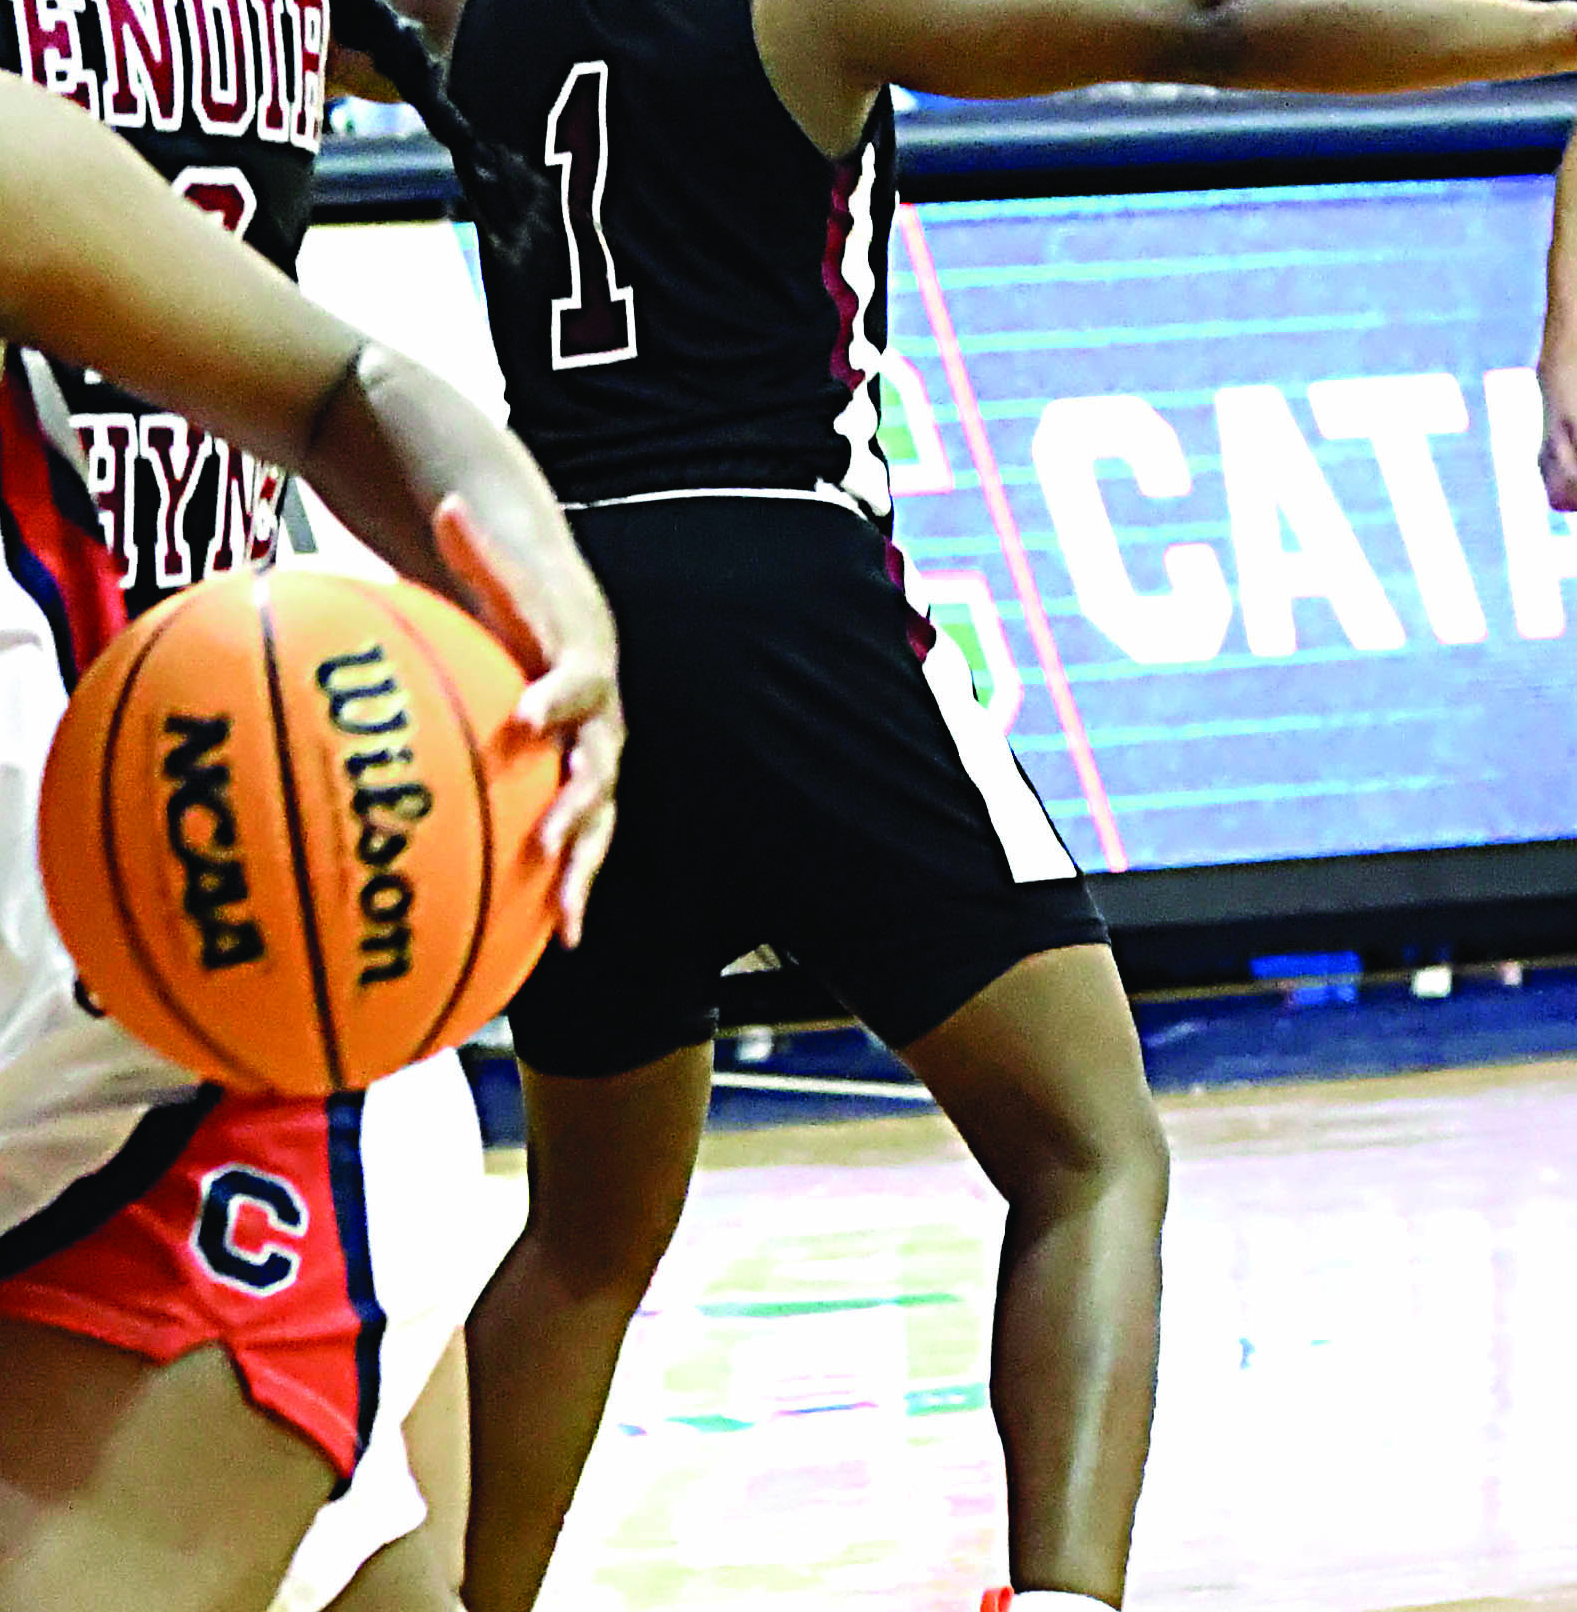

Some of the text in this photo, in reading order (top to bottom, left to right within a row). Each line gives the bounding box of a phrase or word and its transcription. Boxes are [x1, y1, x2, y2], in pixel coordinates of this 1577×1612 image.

[544, 60, 638, 370] 1
[162, 710, 267, 973] NCAA
[315, 641, 435, 988] Wilson
[188, 1162, 309, 1298] C
